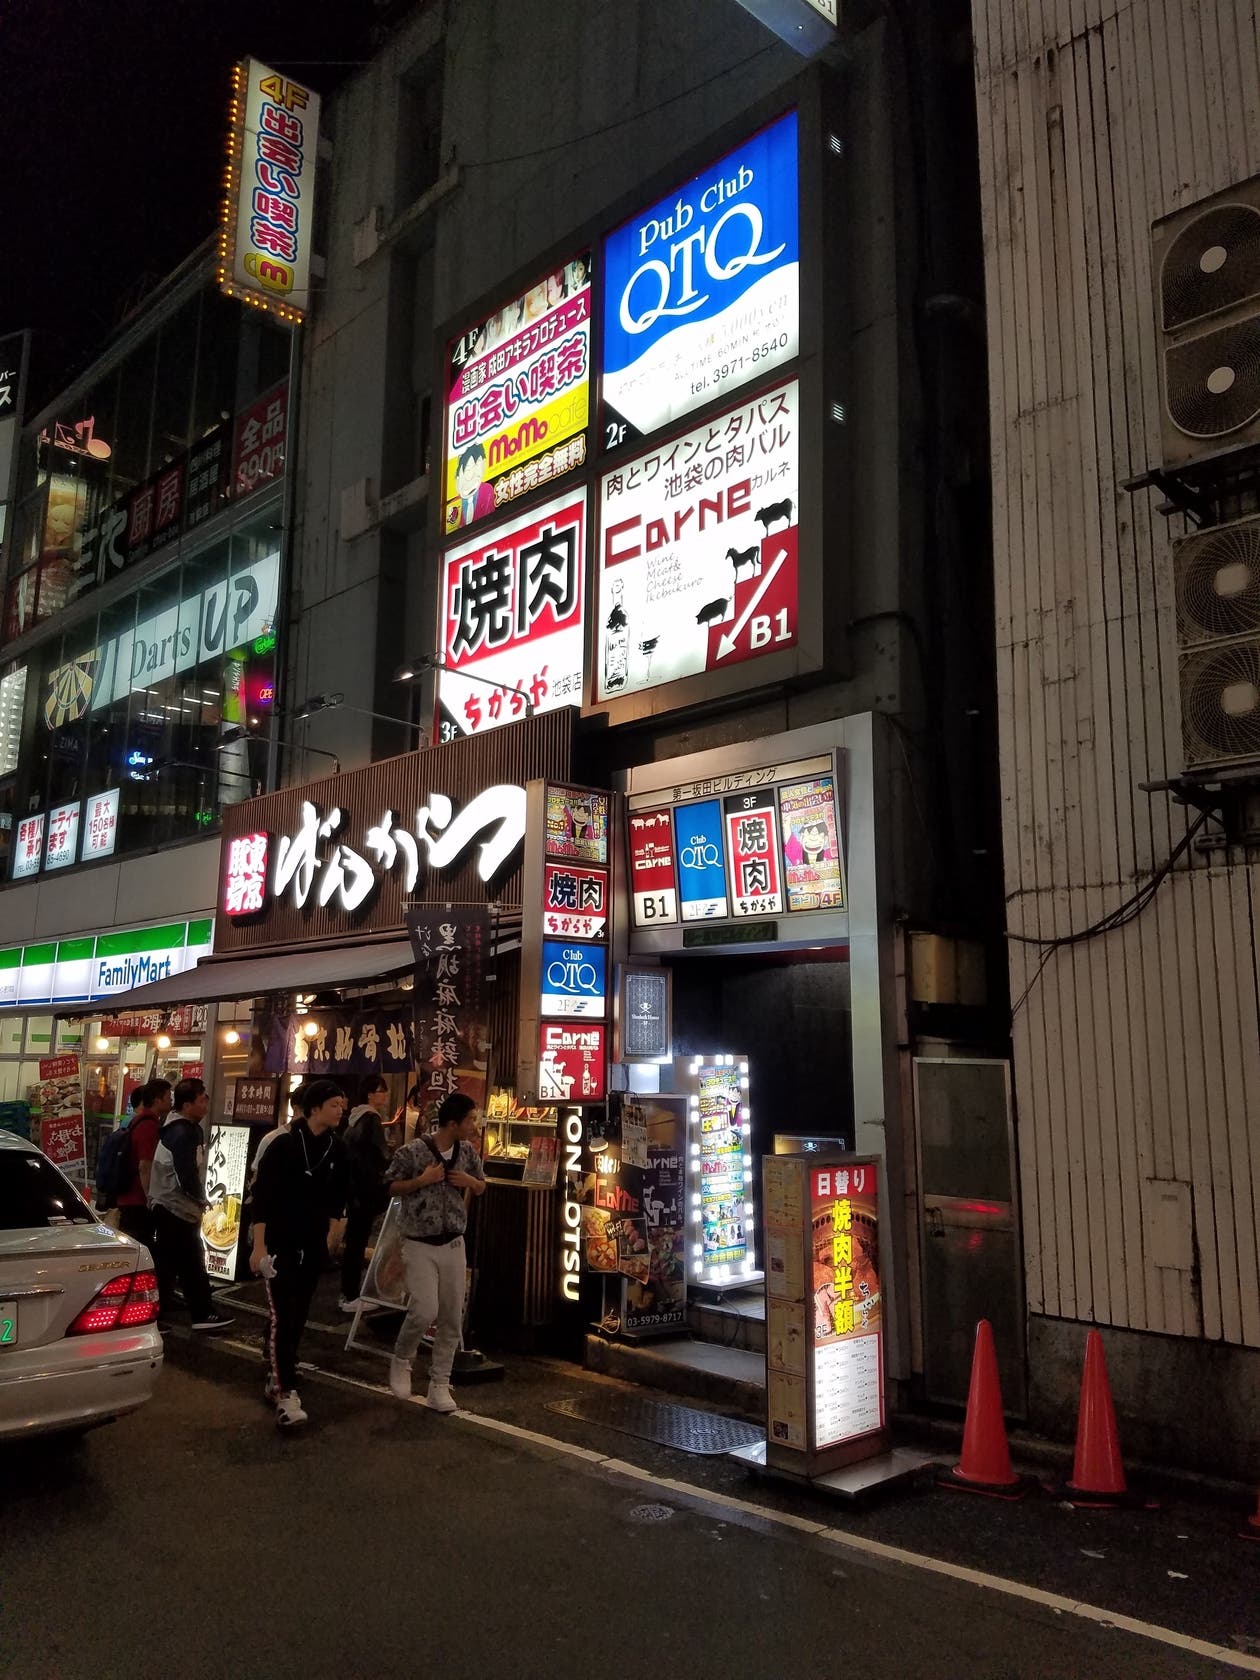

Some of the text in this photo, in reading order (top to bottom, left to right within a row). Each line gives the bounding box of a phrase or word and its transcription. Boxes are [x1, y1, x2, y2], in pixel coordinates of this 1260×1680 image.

[260, 74, 309, 112] 4F
[252, 102, 303, 263] 出会い喫茶
[639, 165, 754, 256] Pub Club
[619, 202, 787, 334] QTQ
[451, 327, 479, 367] 4F
[690, 374, 710, 395] tel.
[712, 332, 789, 383] 3971-8540
[454, 334, 587, 447] 出会い喫茶
[240, 400, 285, 457] 全品
[606, 423, 627, 450] 2F
[607, 392, 790, 499] 肉とワインとタパス
[494, 435, 585, 506] 女性完全無料
[665, 423, 791, 500] 池袋の肉バル
[752, 461, 792, 491] カルネ
[452, 525, 577, 658] 焼肉
[130, 625, 192, 682] Darts
[203, 575, 258, 652] UP
[750, 607, 792, 651] B1
[464, 665, 549, 731] ちからや
[441, 720, 457, 743] 3F
[672, 768, 778, 800] 第一坂田ビルディング
[743, 797, 757, 808] 3F
[274, 784, 526, 912] ばんから
[680, 844, 722, 869] QTQ
[690, 835, 707, 845] Club
[739, 817, 770, 896] 焼肉
[548, 872, 604, 911] 焼肉
[643, 895, 670, 919] B1
[740, 899, 776, 912] ちからや
[821, 892, 841, 906] 4F
[547, 915, 593, 935] ちからや
[98, 954, 172, 990] FamilyMart
[562, 949, 583, 961] Club
[547, 962, 601, 994] QTQ
[540, 1086, 556, 1099] B1
[817, 1168, 865, 1196] 日替り
[832, 1198, 855, 1335] 焼肉半額
[1, 1320, 14, 1343] 2
[627, 1311, 682, 1327] 03-5979-8717
